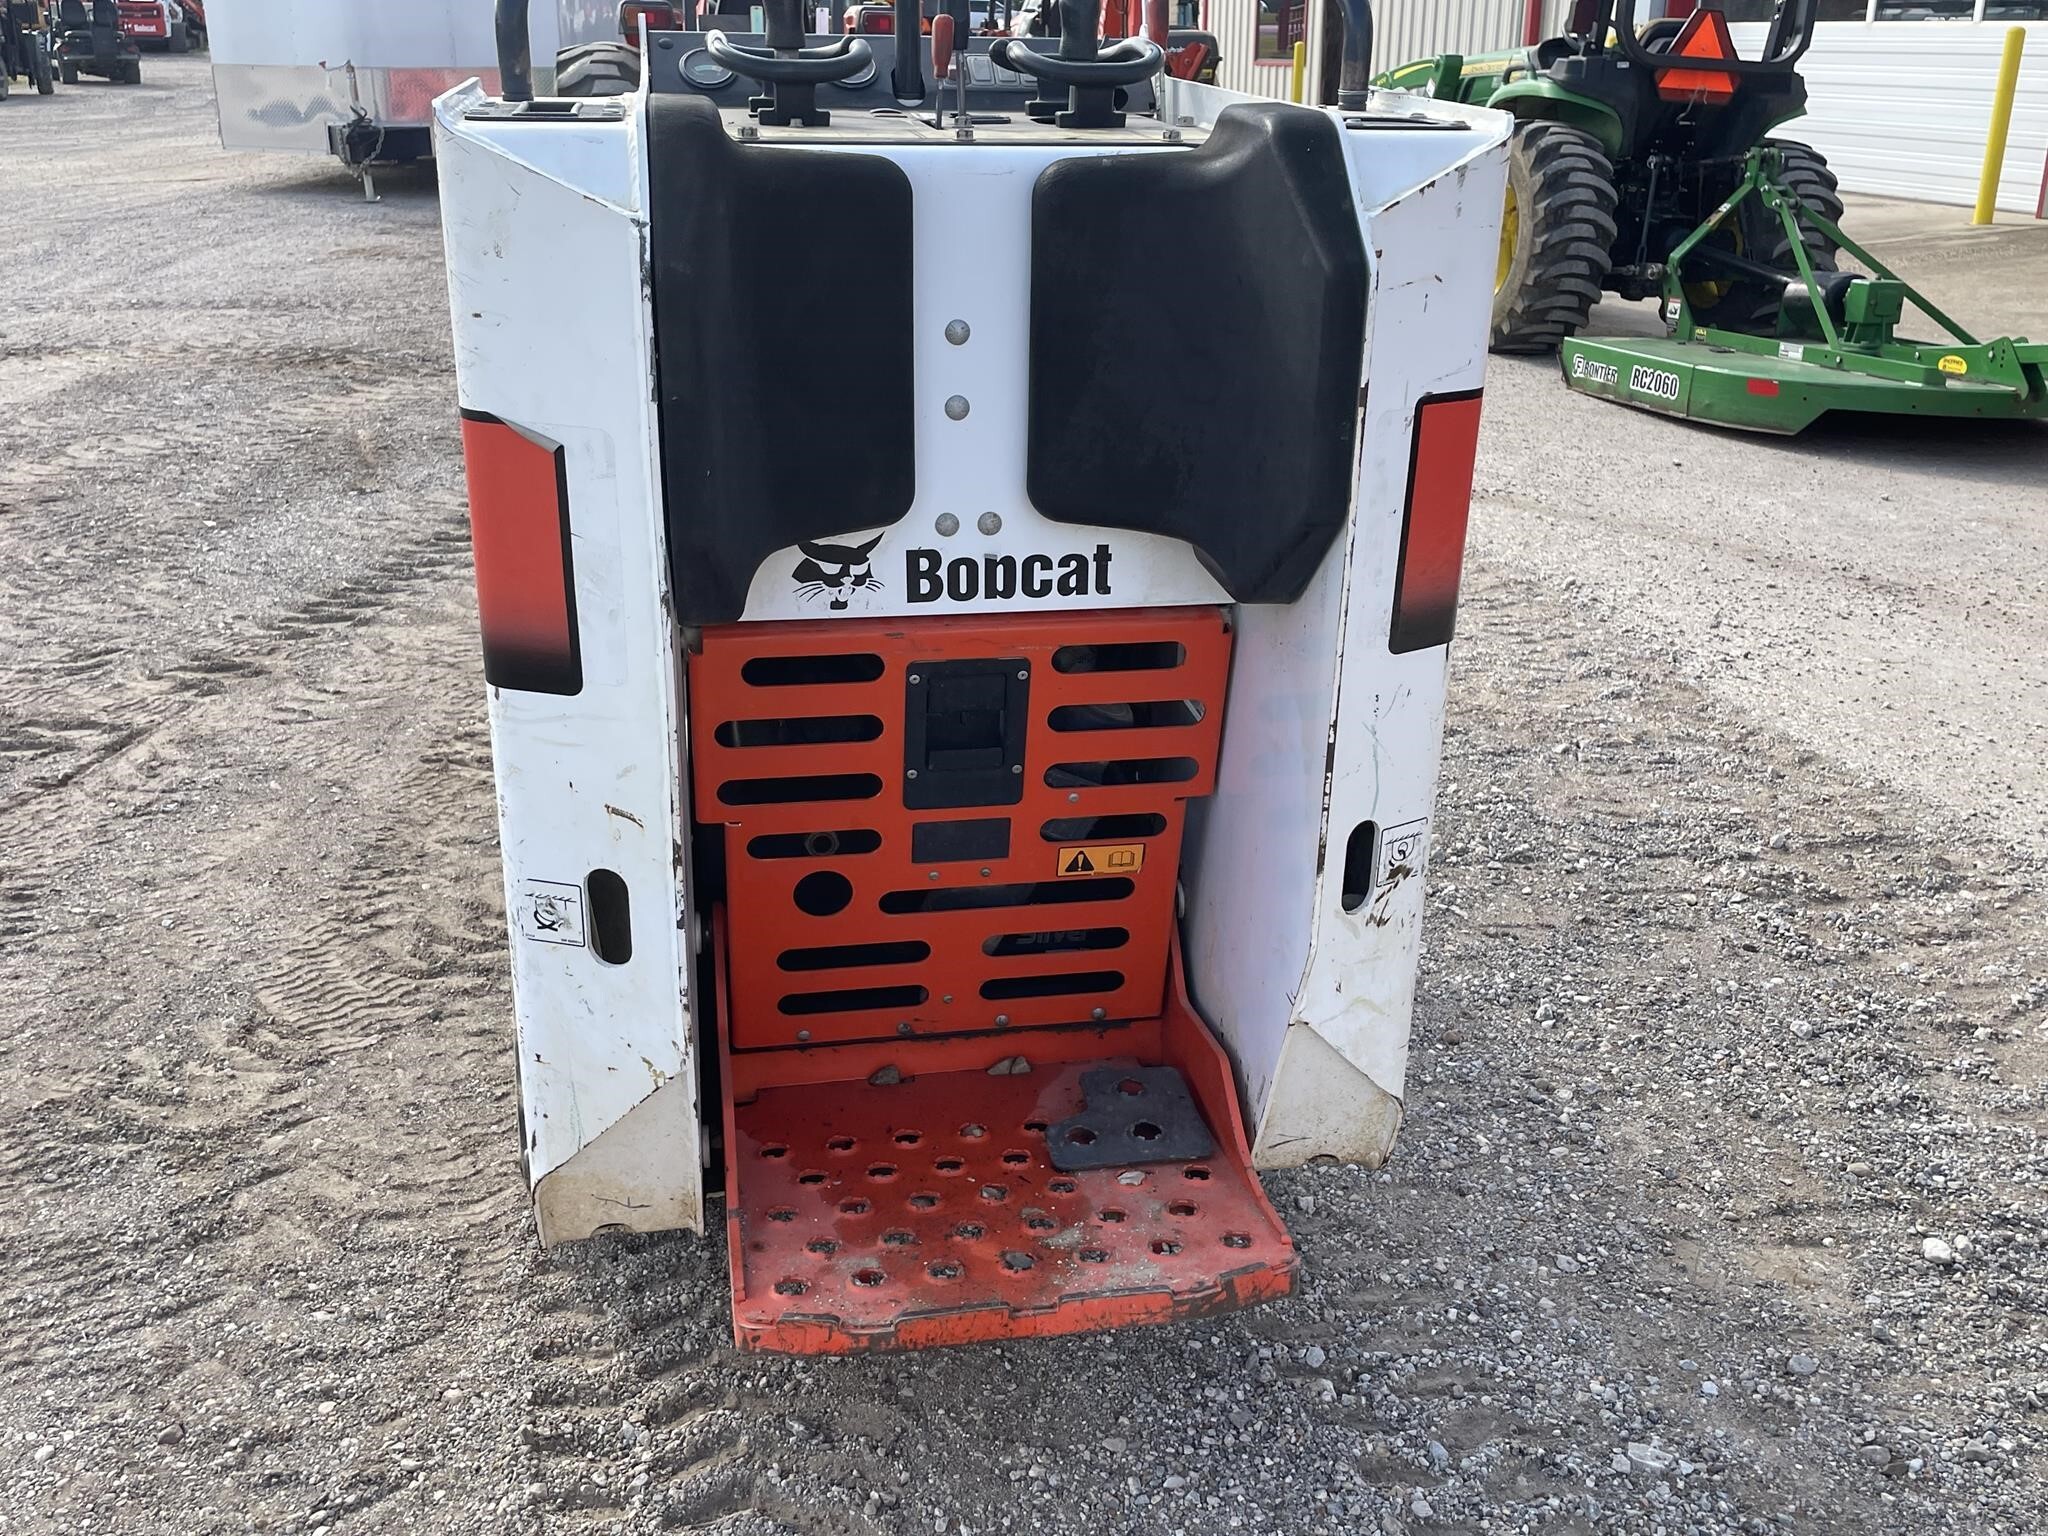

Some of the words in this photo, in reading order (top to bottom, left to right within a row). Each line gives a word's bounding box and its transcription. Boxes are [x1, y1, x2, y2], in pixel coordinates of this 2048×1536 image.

[1572, 354, 1618, 384] FRONTIER
[1631, 366, 1678, 398] RC2060
[905, 543, 1113, 604] Bobcat
